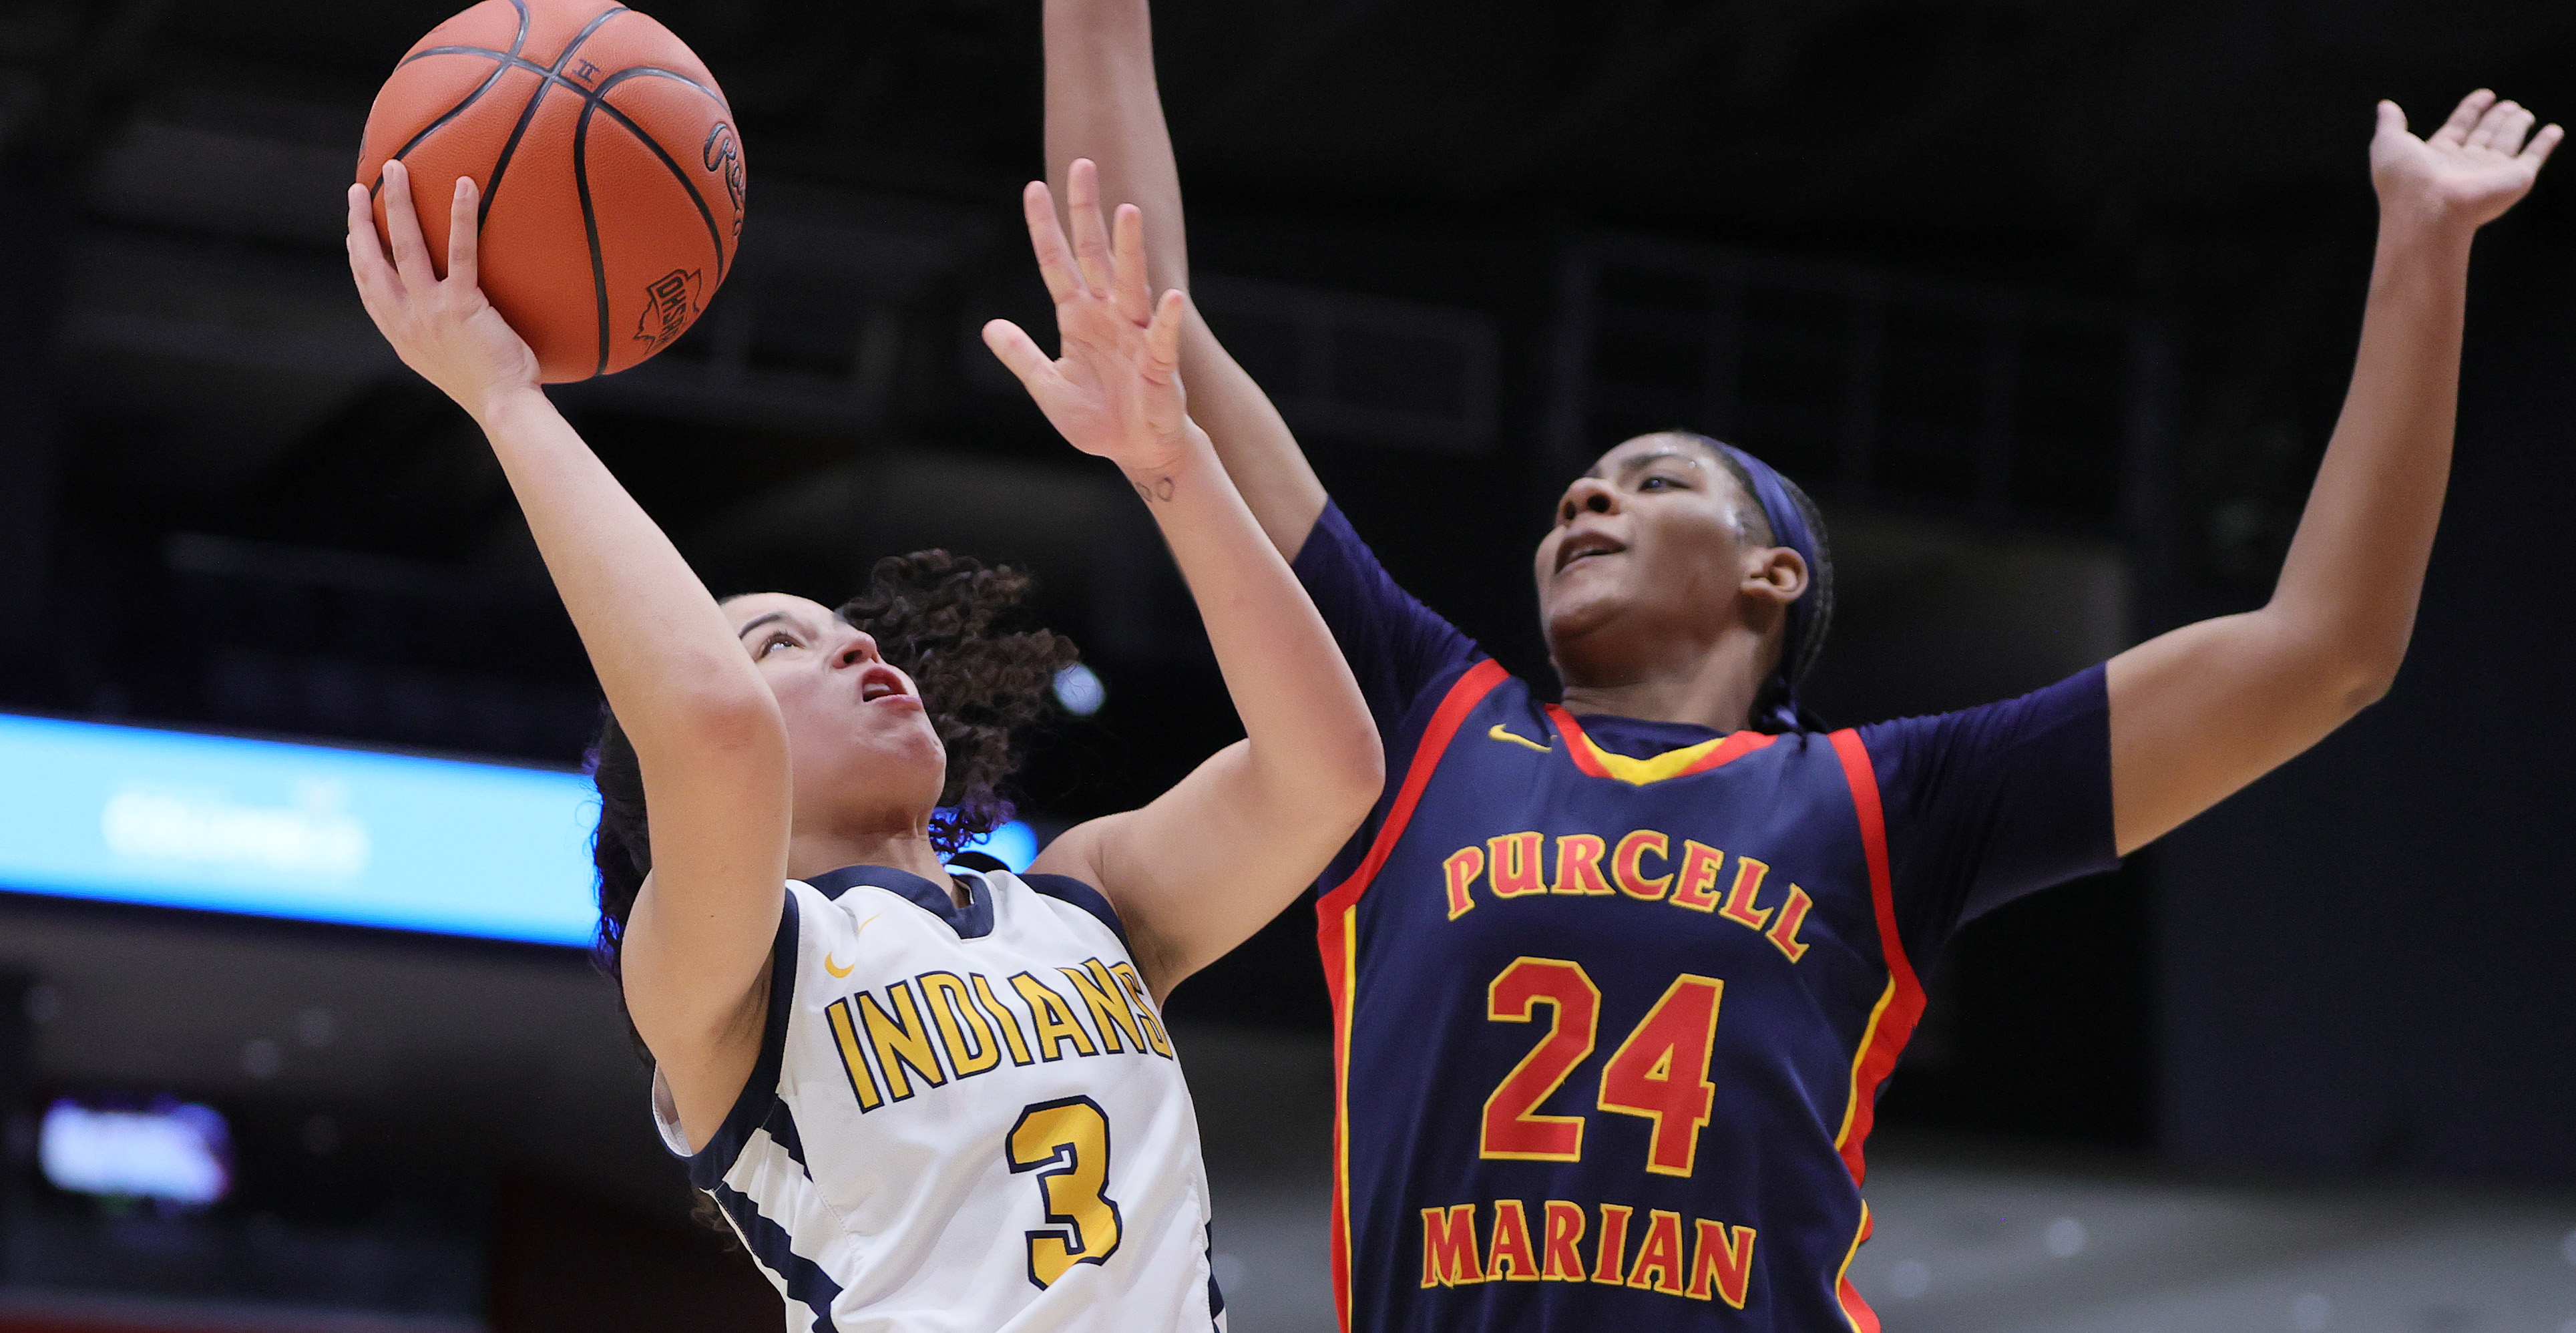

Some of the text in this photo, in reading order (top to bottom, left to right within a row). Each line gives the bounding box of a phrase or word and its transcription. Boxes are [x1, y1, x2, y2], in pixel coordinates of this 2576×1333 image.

[1444, 829, 1813, 963] PURCELL
[825, 957, 1173, 1114] INDIANS
[1479, 956, 1724, 1177] 24
[1006, 1095, 1122, 1291] 3
[1420, 1199, 1757, 1310] MARIAN
